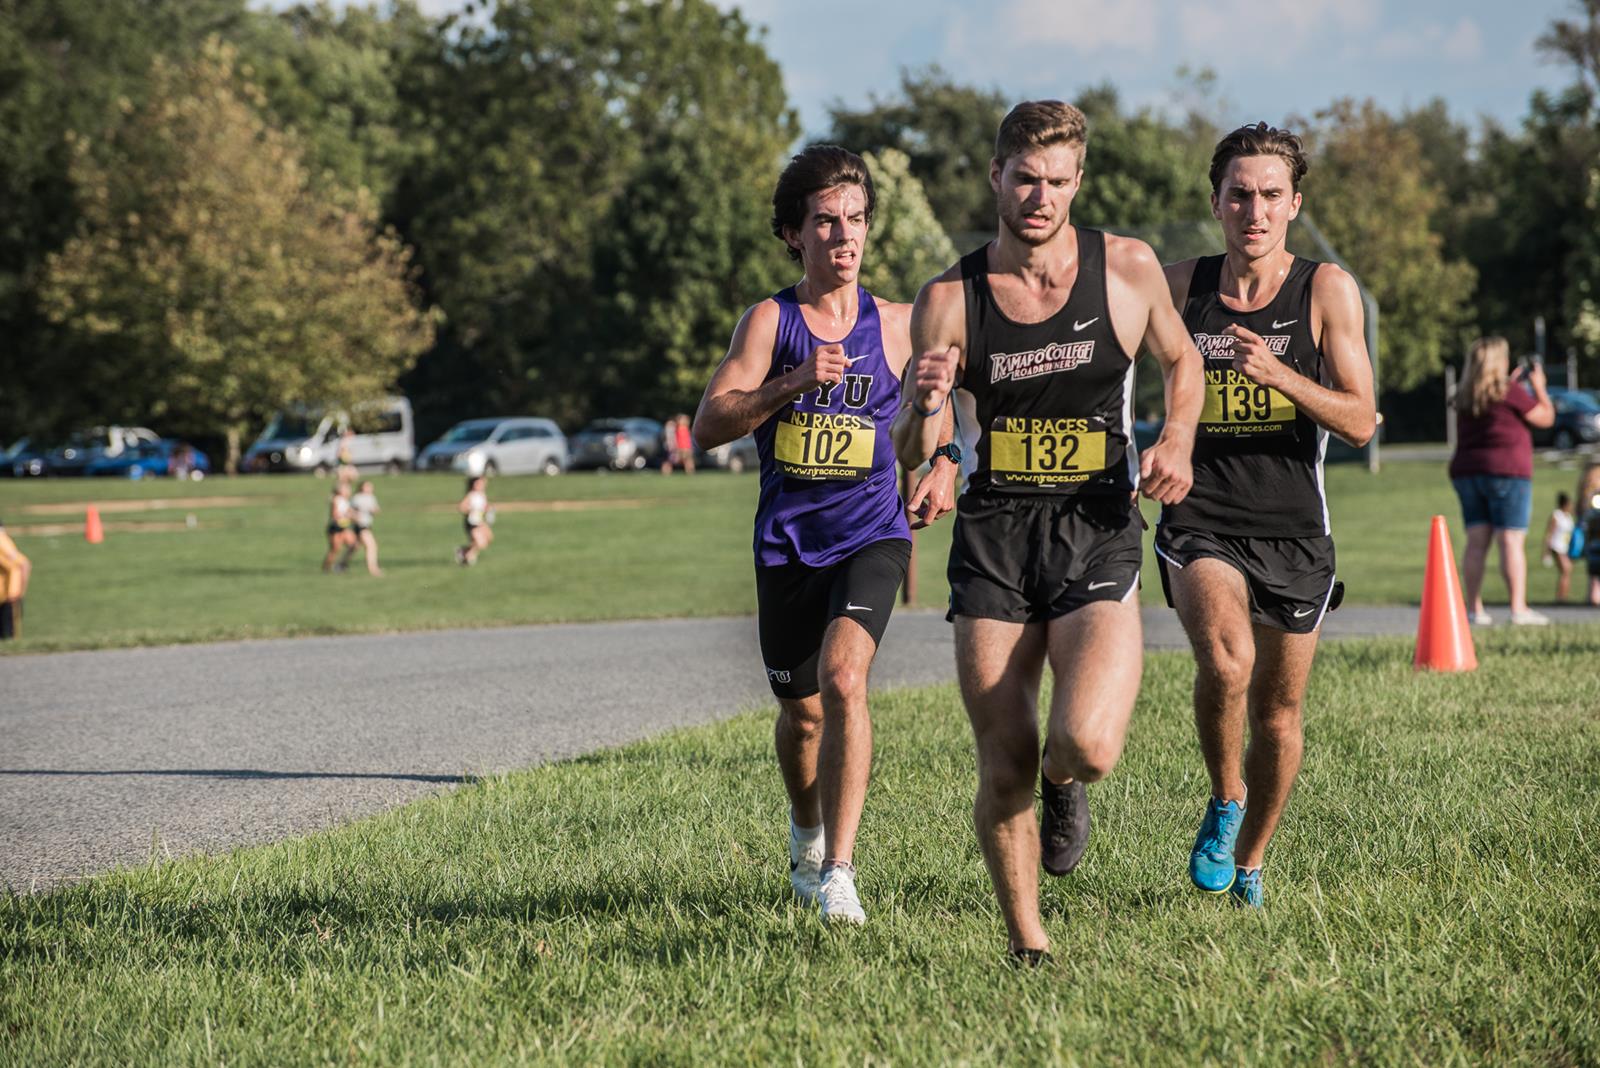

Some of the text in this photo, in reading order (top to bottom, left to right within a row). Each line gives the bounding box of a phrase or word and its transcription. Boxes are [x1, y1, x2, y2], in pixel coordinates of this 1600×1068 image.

[1195, 335, 1234, 354] RAMAP
[992, 343, 1092, 380] RAMAPO COLLEGE
[1205, 369, 1222, 384] NJ
[1217, 385, 1272, 422] 139
[791, 412, 861, 429] NJ RACES
[1006, 418, 1089, 433] NJ RACES
[1206, 423, 1282, 434] www.njraces.com
[801, 428, 853, 465] 102
[1020, 434, 1080, 471] 132
[784, 464, 857, 478] www.njraces.com
[1006, 472, 1090, 485] www.njraces.com
